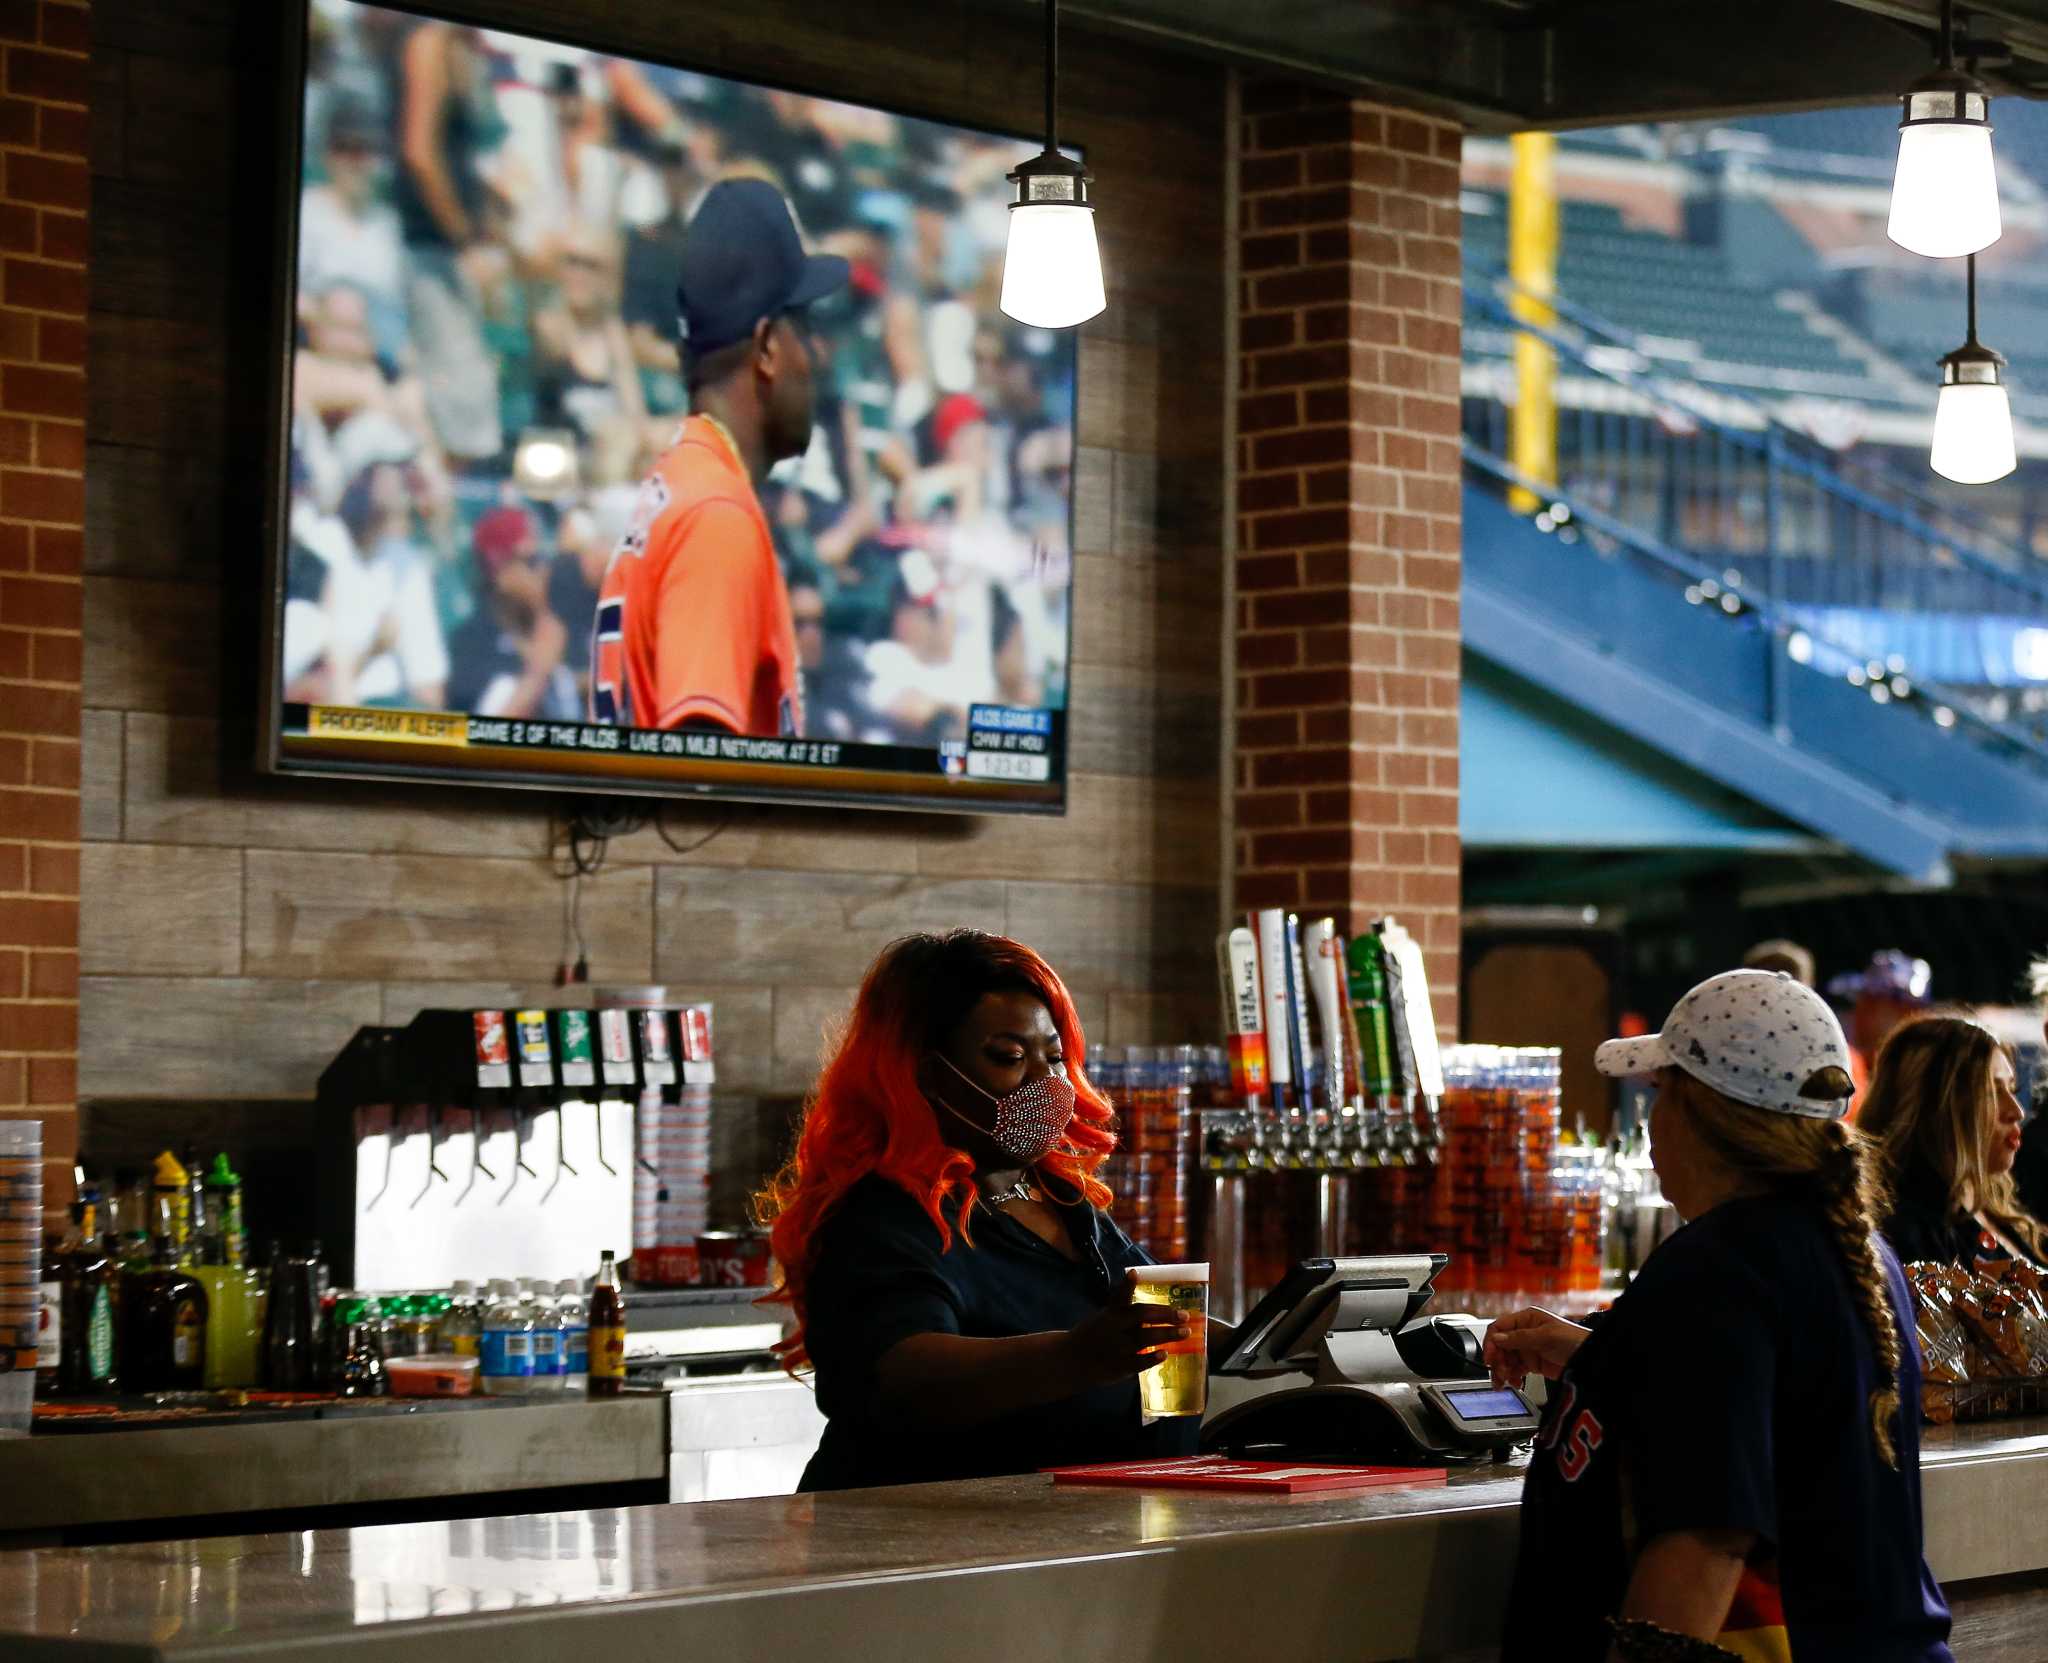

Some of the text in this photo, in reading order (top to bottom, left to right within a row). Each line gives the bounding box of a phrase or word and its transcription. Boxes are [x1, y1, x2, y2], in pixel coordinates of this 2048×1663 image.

[319, 710, 456, 738] PROGRAM ALERT
[1003, 711, 1035, 730] GAME
[468, 720, 841, 764] GAME 2 OF THE ALDS LIVE ON MLB NETWORK AT 2 ET
[1003, 732, 1018, 750] AT
